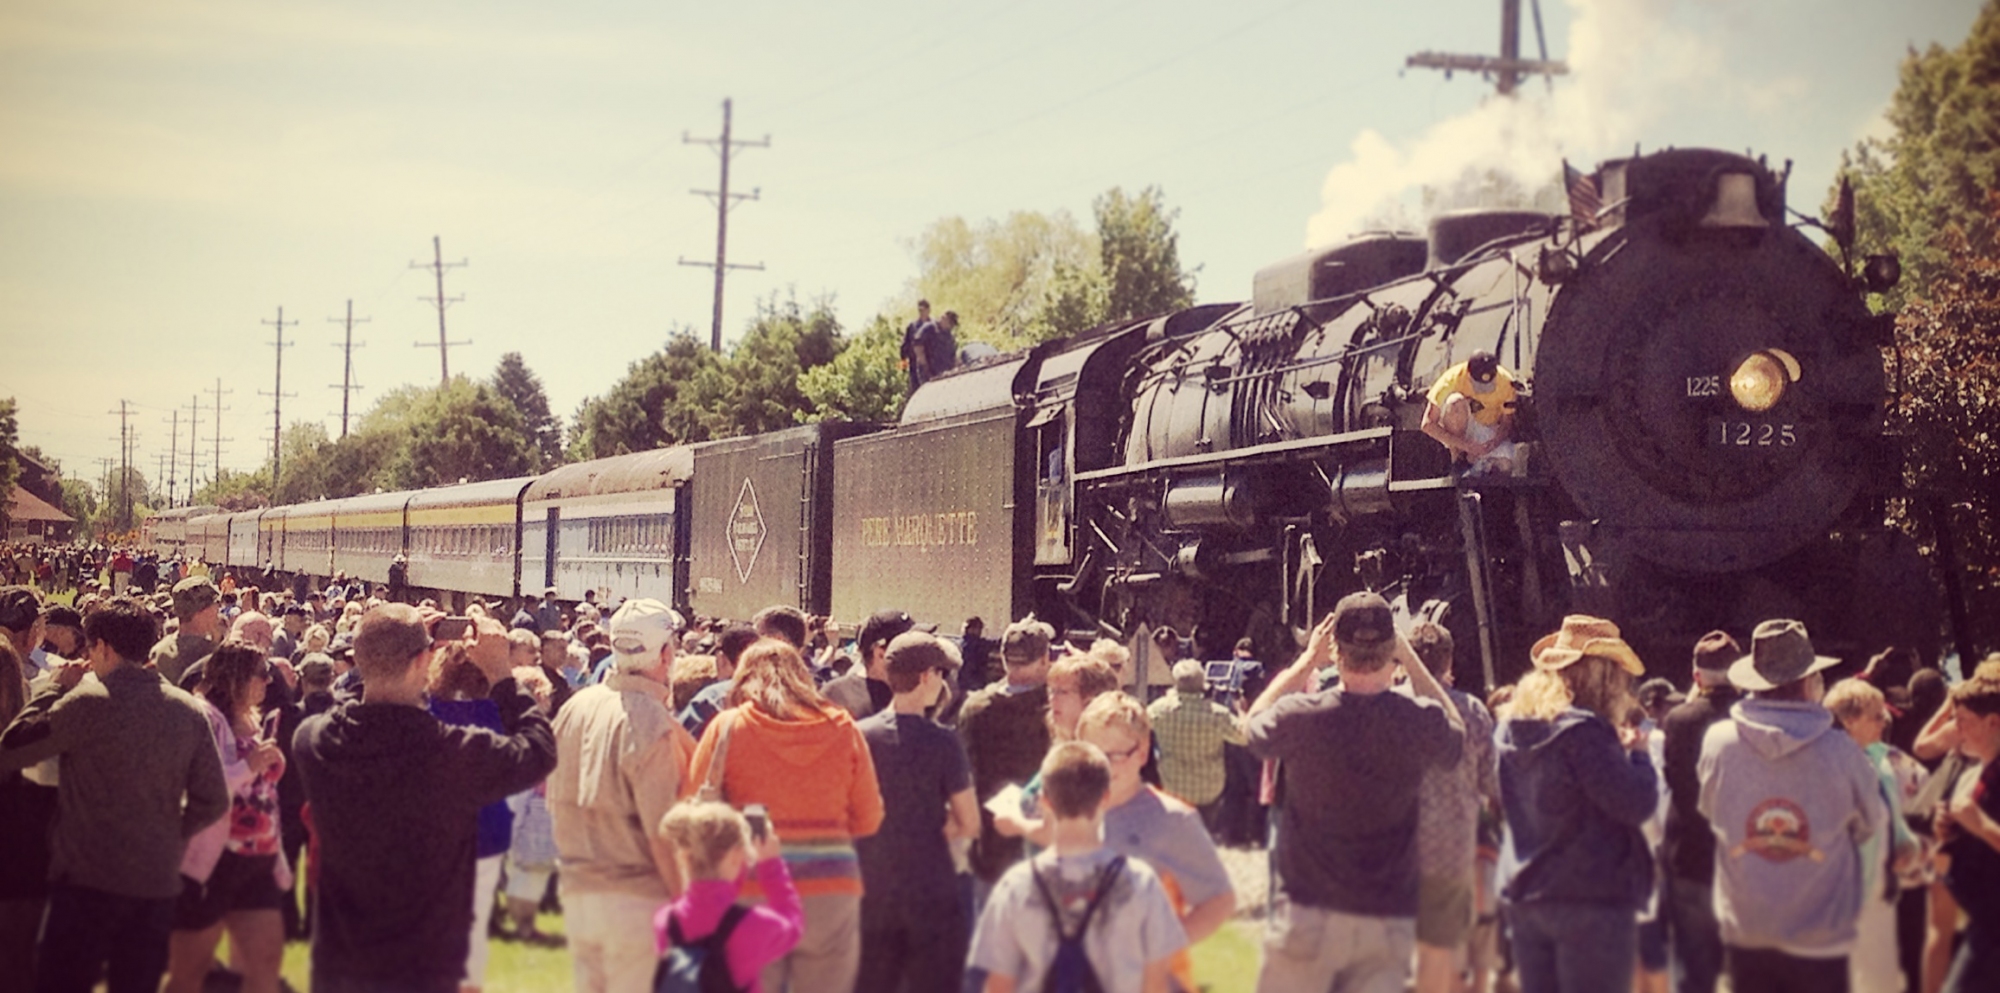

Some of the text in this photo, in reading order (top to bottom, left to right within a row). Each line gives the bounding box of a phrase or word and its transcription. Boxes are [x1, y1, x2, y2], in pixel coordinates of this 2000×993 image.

[1687, 376, 1720, 396] 1225
[1720, 422, 1796, 446] 1225
[861, 511, 978, 553] PERE MARQUETTE
